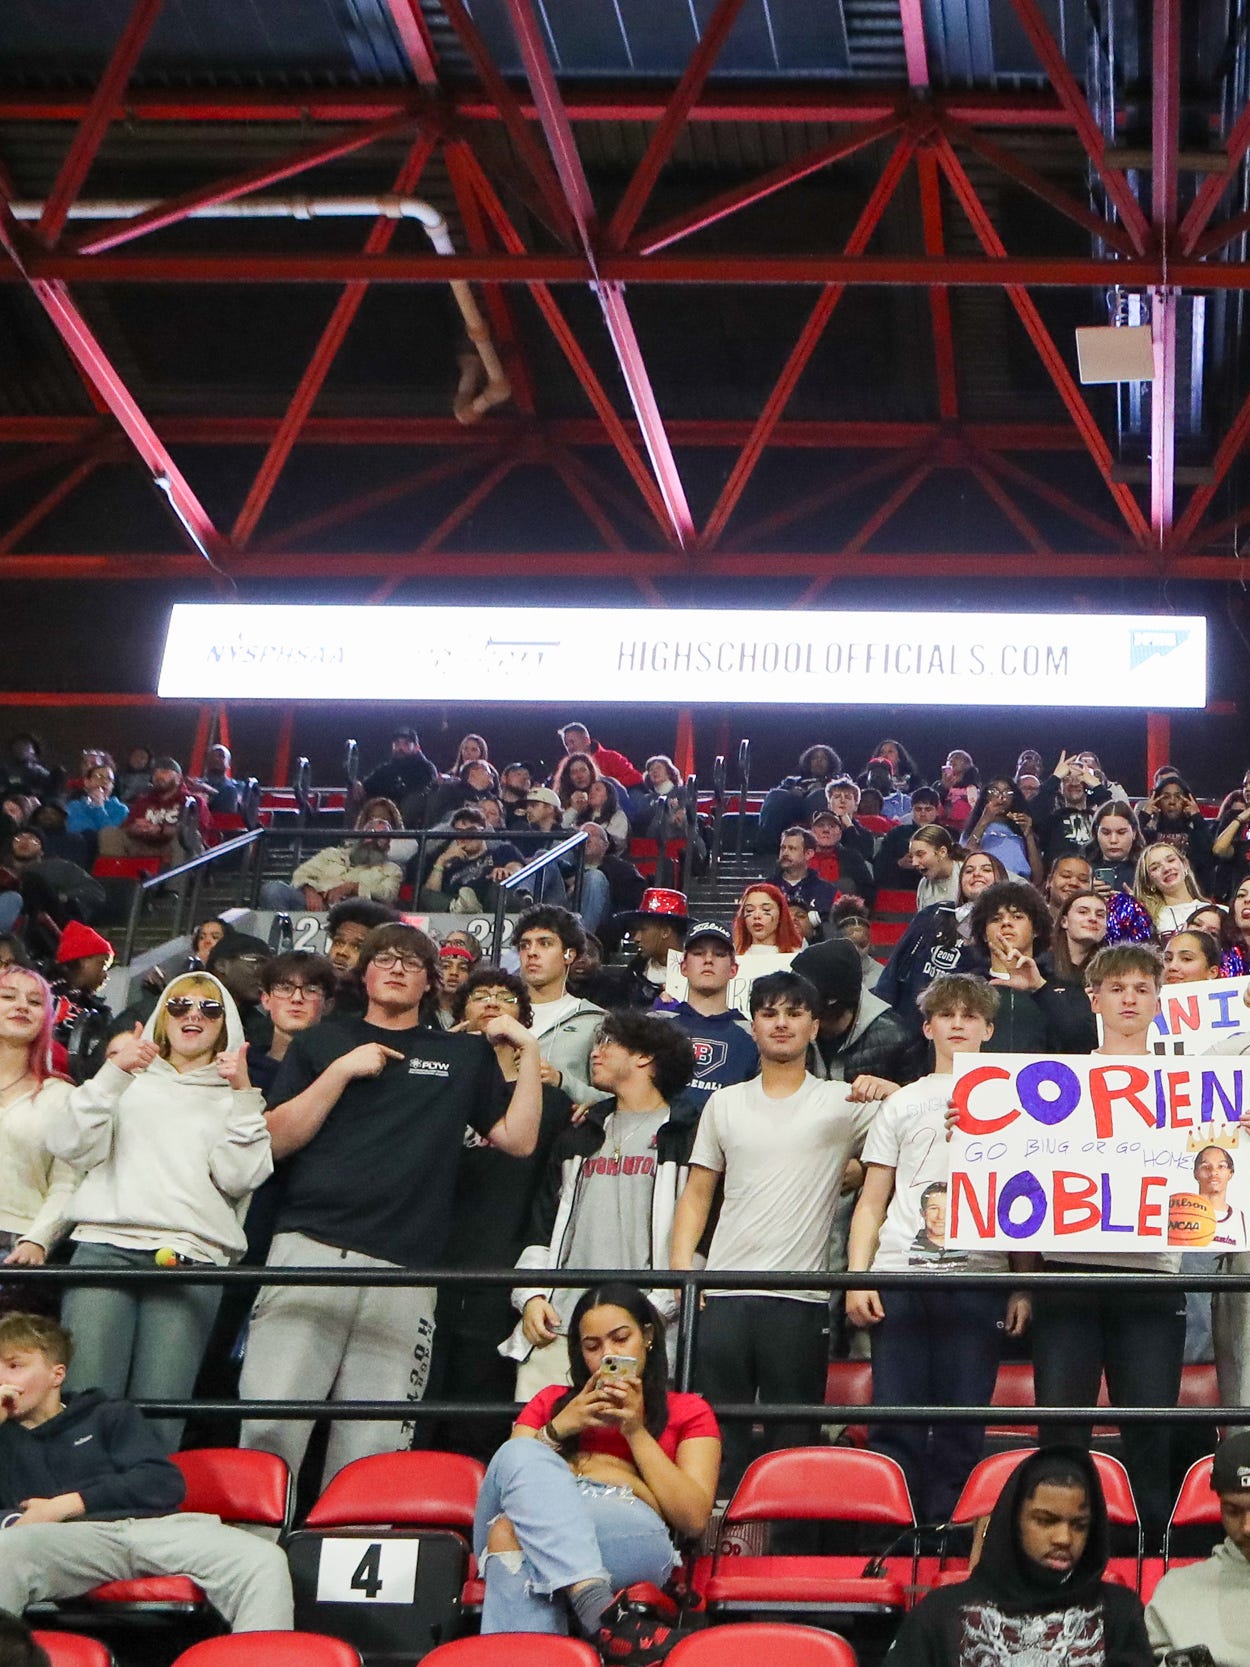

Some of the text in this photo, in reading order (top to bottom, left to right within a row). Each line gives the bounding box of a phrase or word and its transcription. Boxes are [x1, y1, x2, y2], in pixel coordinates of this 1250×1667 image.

[617, 641, 1069, 676] HIGHSCHOOLOFFICIALS.COM
[936, 949, 955, 962] 2019
[692, 1042, 713, 1066] B
[952, 1060, 1243, 1139] CORIEN
[964, 1141, 1008, 1163] GO
[1025, 1138, 1069, 1157] BING
[1081, 1142, 1105, 1154] OR
[1116, 1141, 1142, 1154] GO
[950, 1170, 1168, 1239] NOBLE
[350, 1543, 384, 1599] 4
